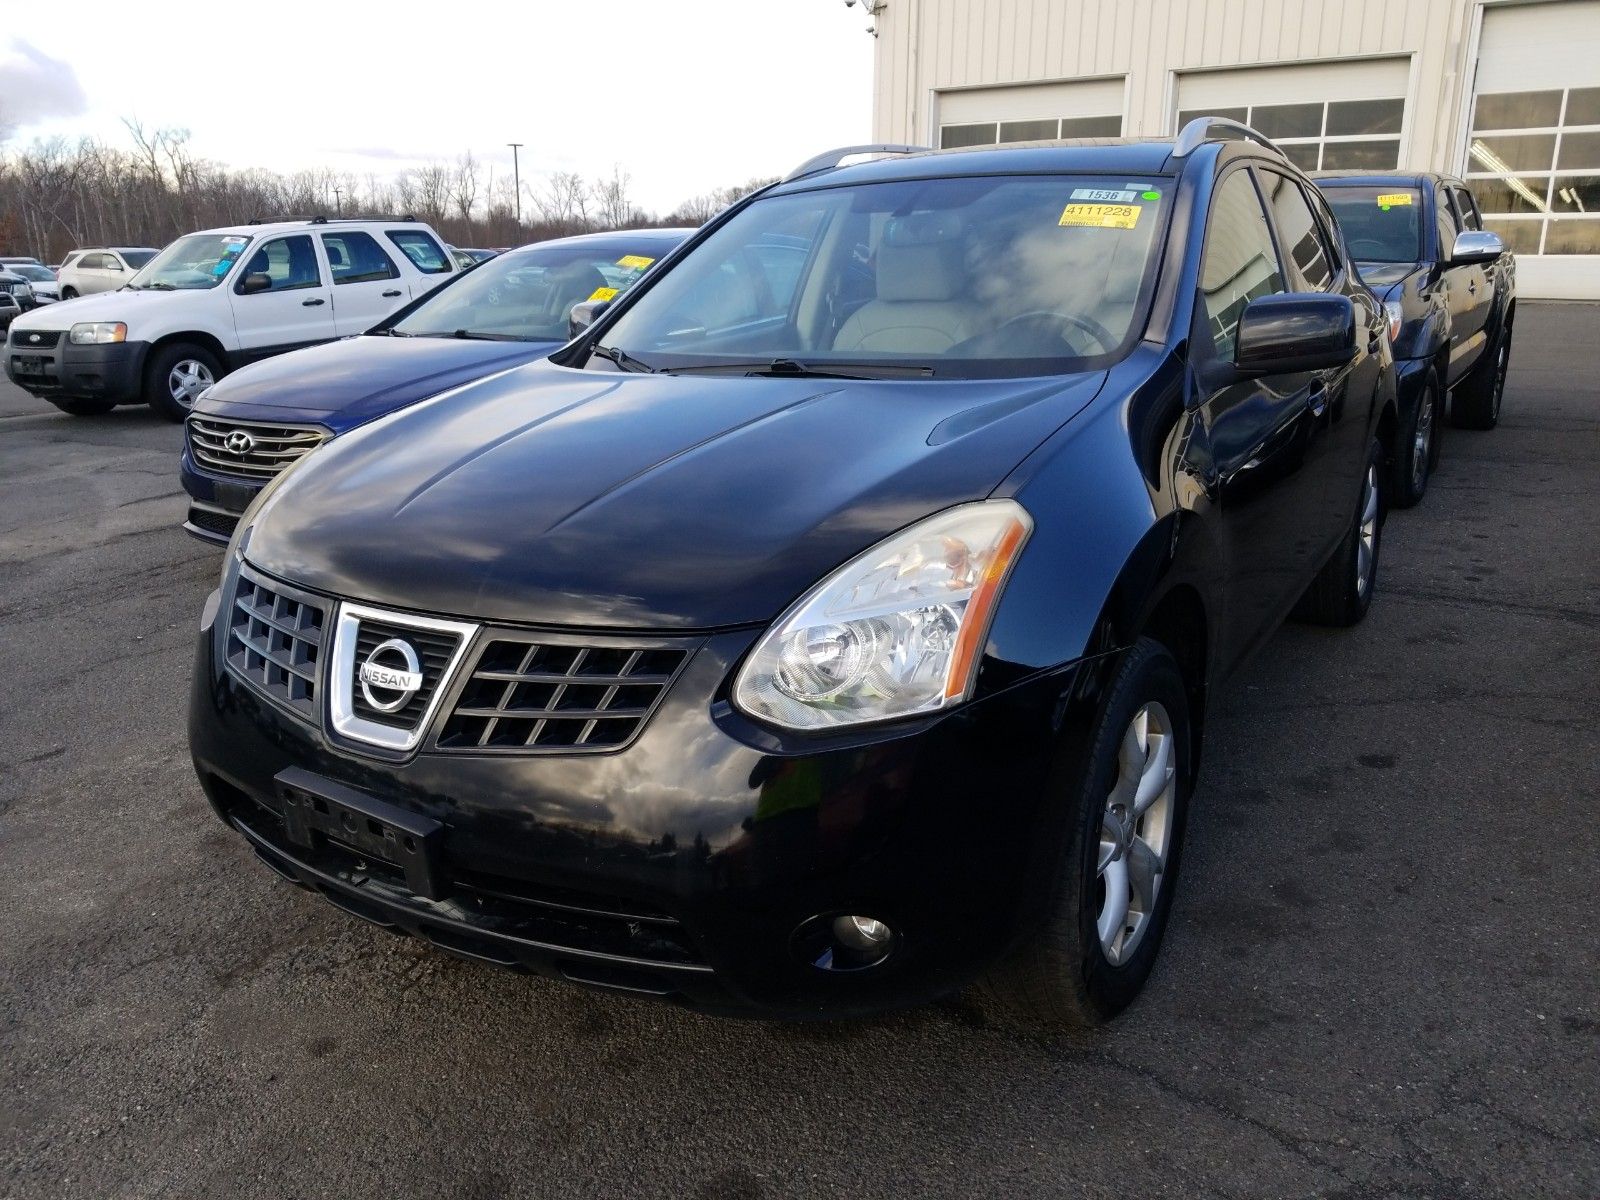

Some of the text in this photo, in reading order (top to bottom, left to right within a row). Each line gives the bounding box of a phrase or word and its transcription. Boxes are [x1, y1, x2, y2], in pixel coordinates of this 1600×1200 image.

[1088, 190, 1120, 200] 1536
[1066, 206, 1132, 217] 4111228
[361, 664, 412, 688] NISSAN
